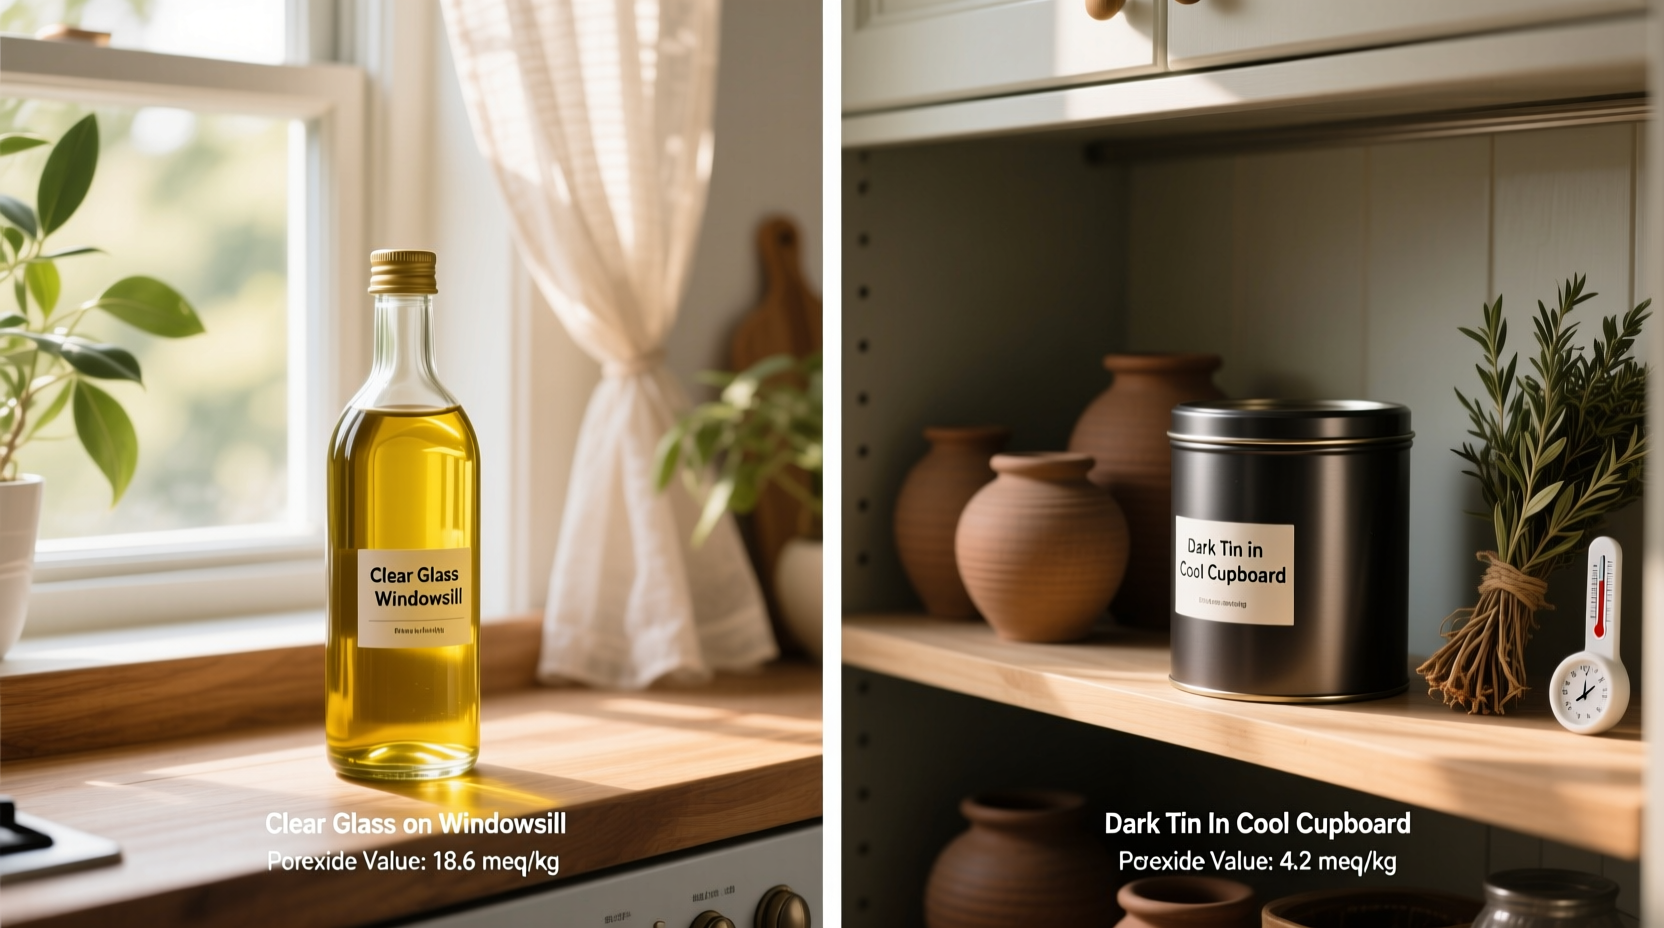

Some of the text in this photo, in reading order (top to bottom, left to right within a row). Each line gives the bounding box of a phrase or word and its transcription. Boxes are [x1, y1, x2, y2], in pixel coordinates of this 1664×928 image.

[1187, 537, 1263, 558] Dark Tin in
[370, 566, 459, 584] Clear Glass
[1179, 560, 1286, 586] Cool Cupboard
[374, 587, 463, 607] Windowsill
